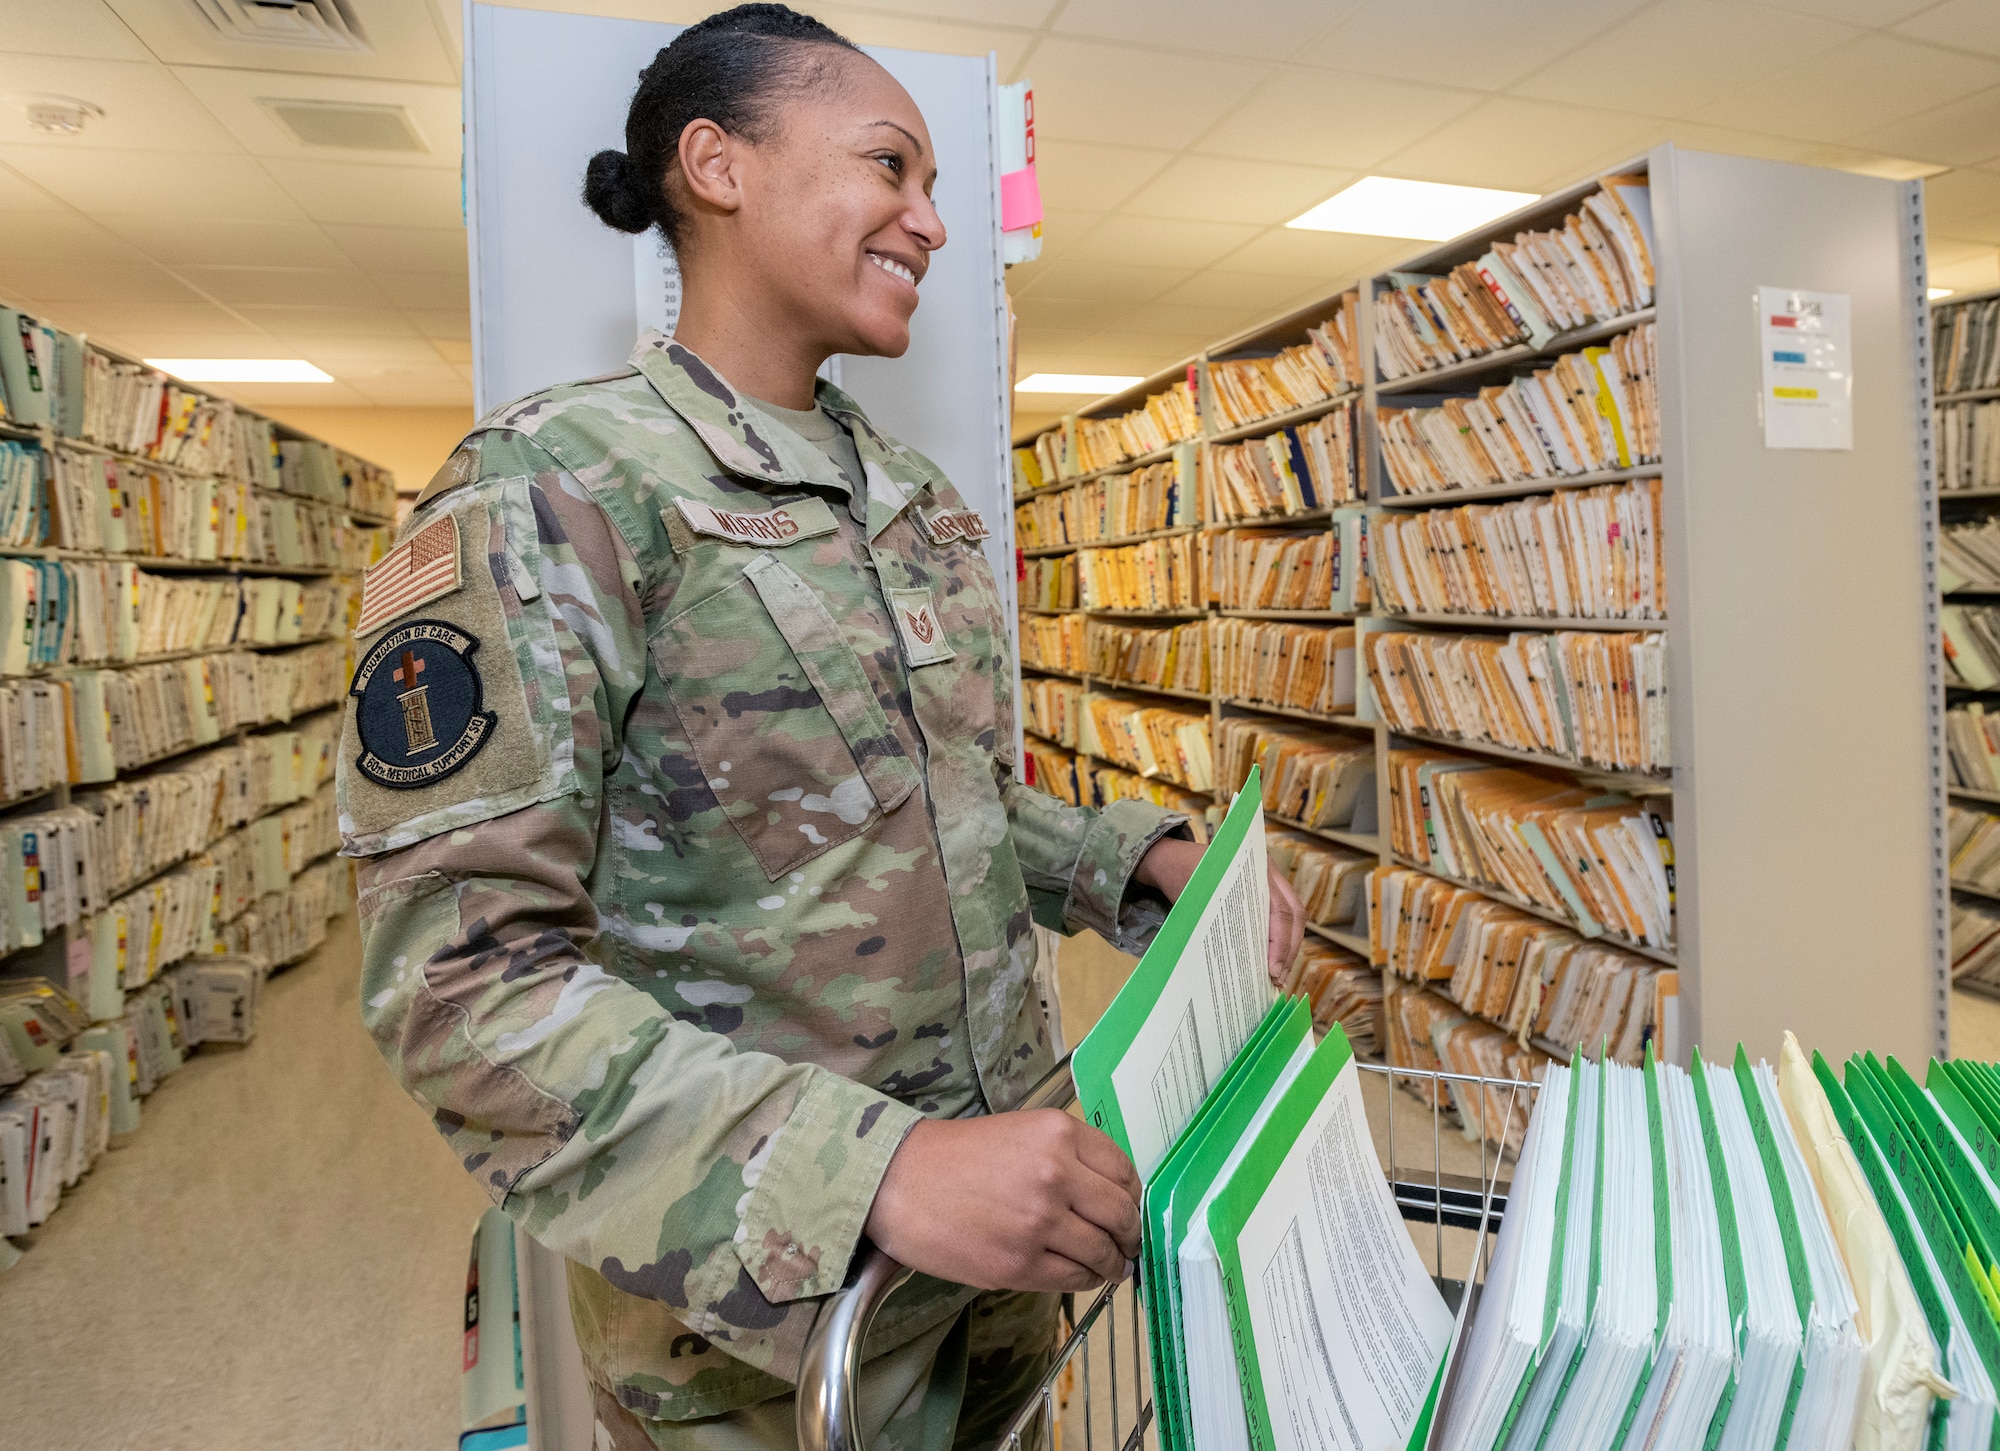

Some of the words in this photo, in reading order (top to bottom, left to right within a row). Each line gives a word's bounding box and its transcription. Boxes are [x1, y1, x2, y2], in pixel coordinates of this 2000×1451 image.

[664, 281, 676, 289] 10
[664, 295, 677, 303] 20
[665, 309, 677, 317] 30
[708, 508, 799, 539] MORRIS
[362, 629, 411, 679] FOUNDATION
[414, 626, 427, 638] OF
[429, 626, 457, 645] CARE
[386, 765, 430, 781] MEDICAL
[431, 733, 474, 773] SUPPORT
[1227, 1277, 1235, 1295] 0
[1236, 1329, 1244, 1350] 2
[1241, 1355, 1249, 1377] 3
[1250, 1410, 1258, 1430] 5
